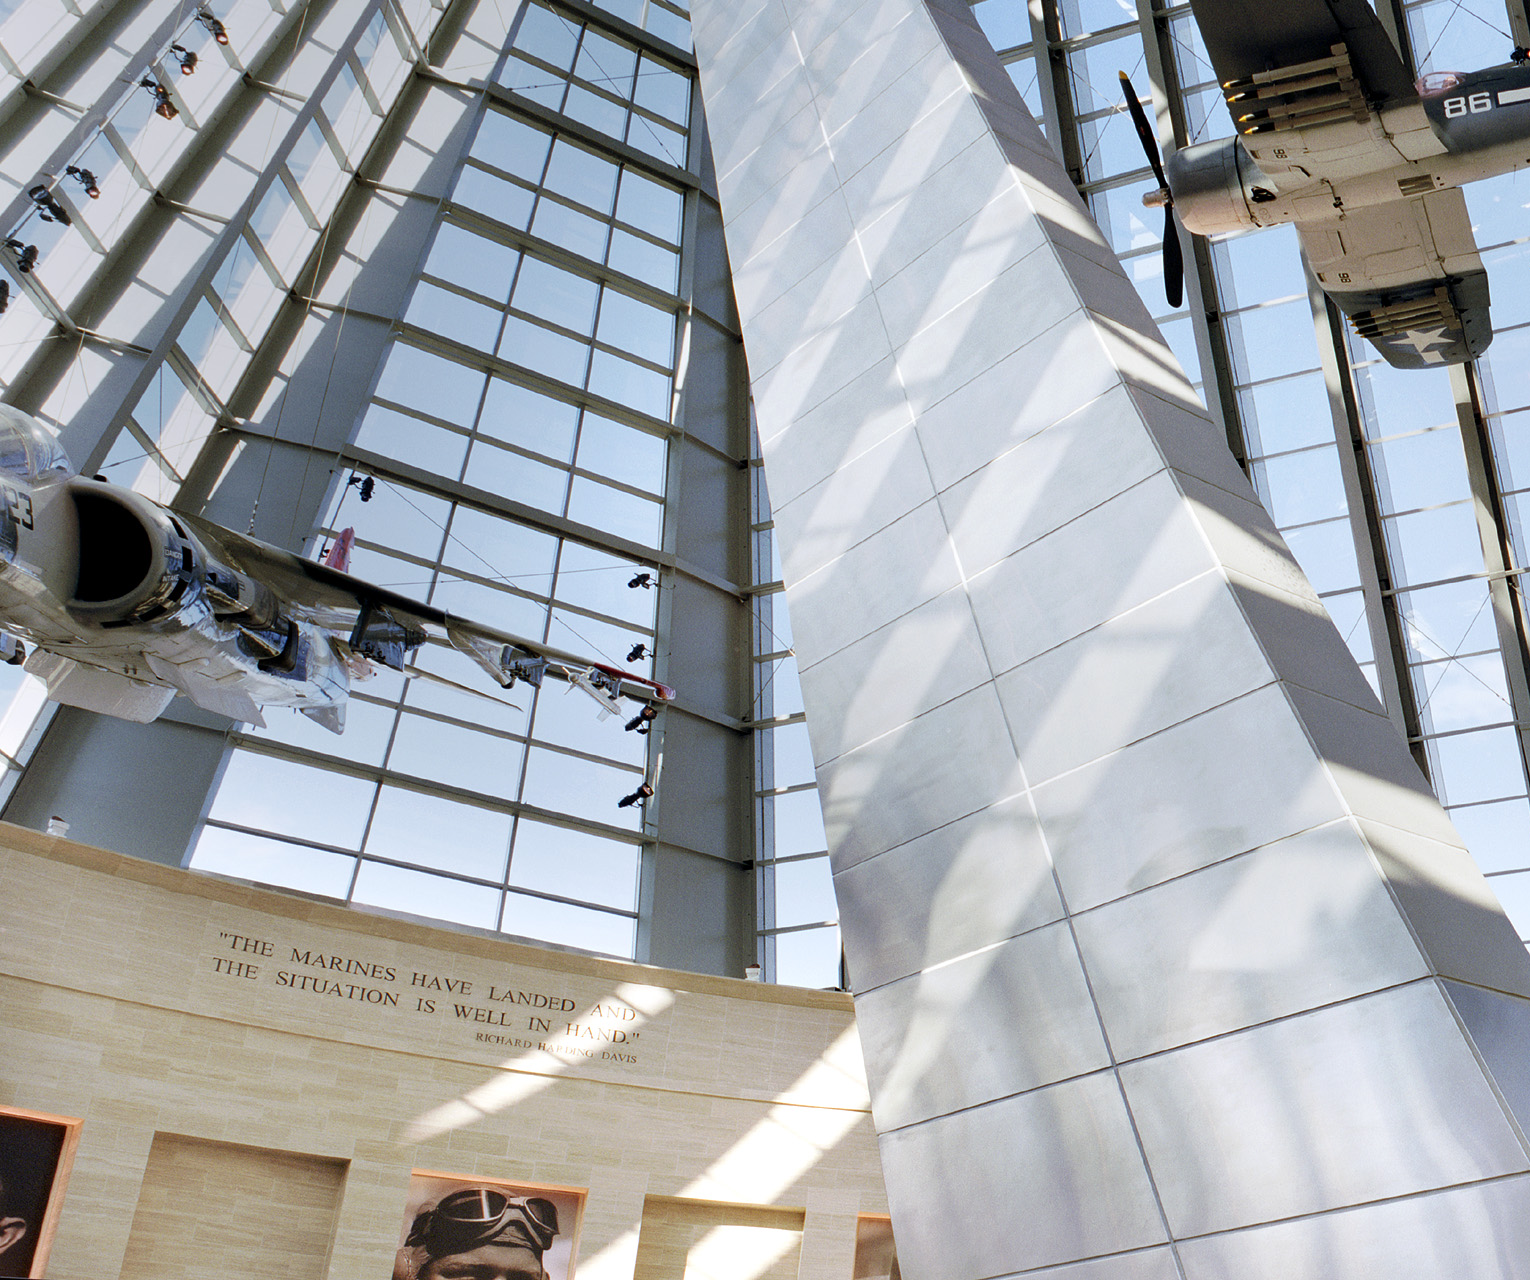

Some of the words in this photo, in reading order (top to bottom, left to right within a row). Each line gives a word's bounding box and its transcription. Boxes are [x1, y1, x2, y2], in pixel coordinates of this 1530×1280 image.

[1443, 91, 1492, 119] 86
[213, 957, 259, 980] THE
[275, 971, 400, 1007] SITUATION
[416, 998, 436, 1014] IS
[453, 1004, 512, 1027] WELL
[528, 1017, 551, 1033] IN
[566, 1023, 640, 1045] HAND."
[219, 932, 275, 957] "THE
[290, 948, 397, 982] MARINES
[410, 972, 473, 996] HAVE
[488, 986, 576, 1013] LANDED
[590, 1004, 636, 1022] AND
[475, 1032, 532, 1049] RICHARD
[538, 1042, 594, 1059] HARDING
[601, 1051, 638, 1064] DAVIS
